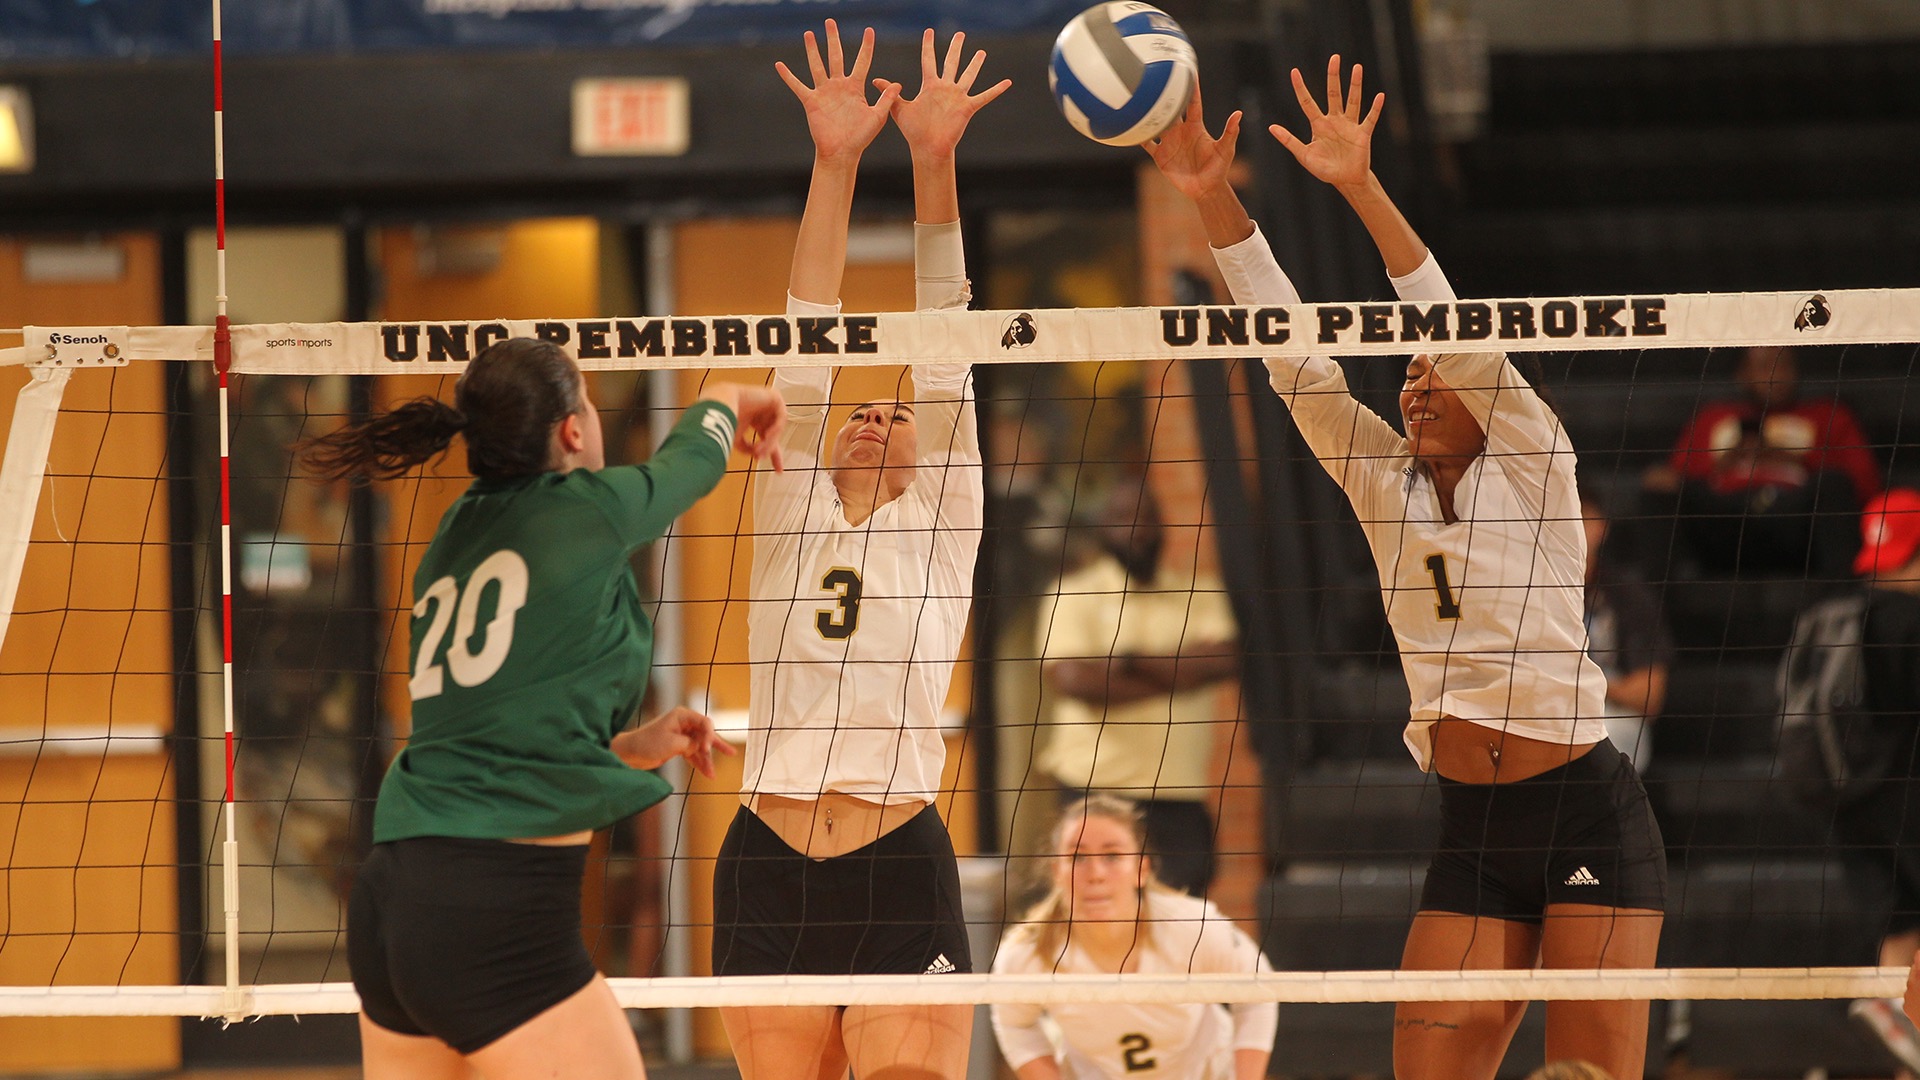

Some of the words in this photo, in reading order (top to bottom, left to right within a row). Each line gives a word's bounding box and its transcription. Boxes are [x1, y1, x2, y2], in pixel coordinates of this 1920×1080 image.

[62, 334, 108, 345] Senoh
[265, 338, 296, 349] sports
[535, 315, 878, 359] PEMBROKE
[1160, 307, 1291, 347] UNC
[1317, 298, 1667, 344] PEMBROKE
[814, 566, 862, 641] 3
[1423, 552, 1464, 622] 1
[408, 549, 529, 701] 20
[1118, 1032, 1156, 1073] 2
